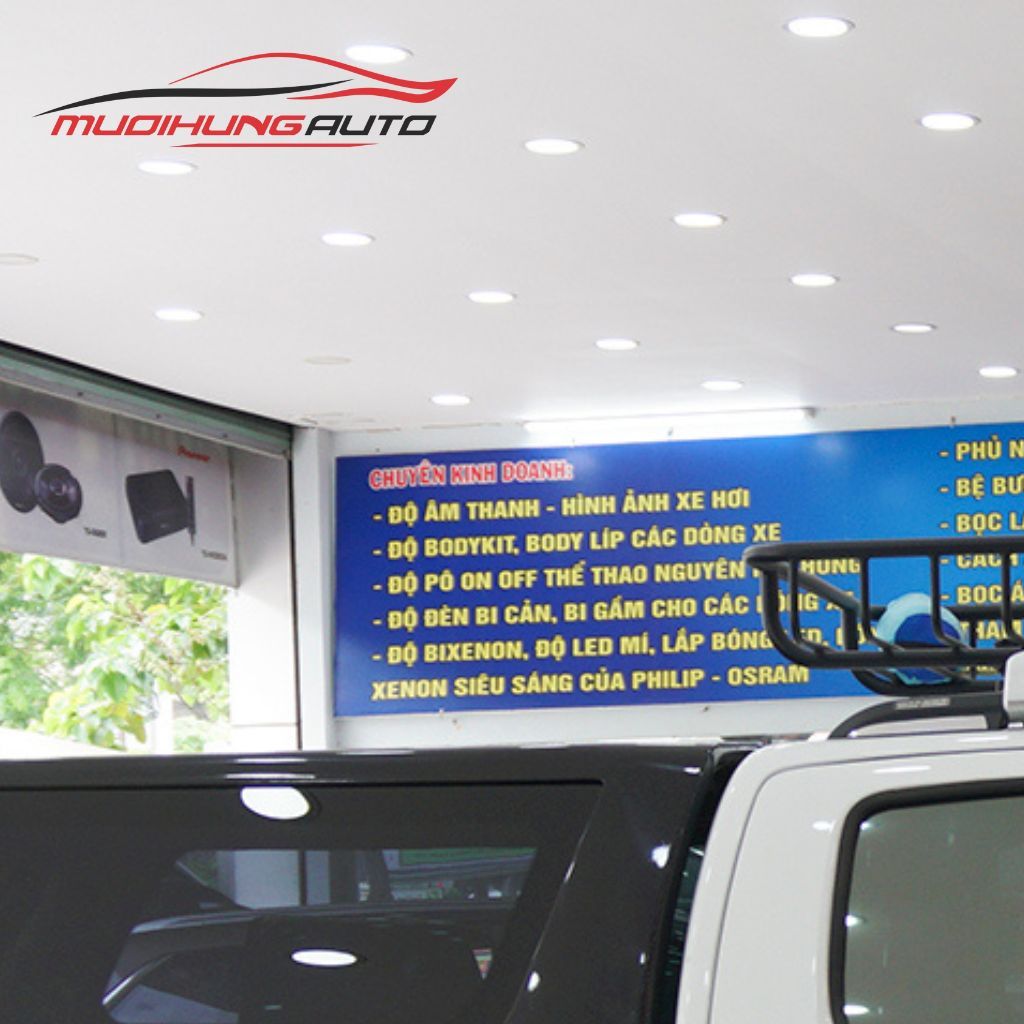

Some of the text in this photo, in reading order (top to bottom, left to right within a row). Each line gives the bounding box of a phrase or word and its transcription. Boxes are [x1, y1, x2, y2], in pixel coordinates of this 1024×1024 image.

[956, 436, 1001, 460] PHỦ
[369, 459, 574, 490] CHUYÊN KINH DOANH:
[956, 474, 984, 498] BỆ
[388, 501, 418, 526] ĐỘ
[424, 500, 460, 521] ÂM
[466, 499, 540, 520] THANH
[562, 494, 616, 516] HÌNH
[622, 489, 669, 512] ẢNH
[676, 491, 704, 510] XE
[712, 488, 749, 508] HƠI
[957, 513, 1001, 536] BỌC
[388, 536, 418, 561] ĐỘ
[424, 535, 519, 557] BODYKIT,
[526, 532, 583, 552] BODY
[631, 525, 676, 548] CÁC
[683, 523, 745, 546] DÒNG
[753, 523, 780, 542] XE
[388, 571, 418, 596] ĐỘ
[424, 570, 454, 592] PÔ
[461, 572, 492, 590] ON
[499, 569, 537, 589] OFF
[591, 564, 648, 584] THAO
[655, 557, 746, 583] NGUYÊN
[388, 606, 418, 632] ĐỘ
[424, 605, 469, 627] ĐÈN
[475, 606, 498, 625] BI
[564, 603, 587, 621] BI
[651, 598, 696, 618] CHO
[704, 593, 749, 616] CÁC
[387, 641, 417, 667] ĐỘ
[424, 641, 528, 662] BIXENON,
[535, 635, 566, 661] ĐỘ
[573, 637, 613, 656] LED
[372, 679, 448, 700] XENON
[454, 674, 505, 696] SIÊU
[511, 672, 573, 694] SÁNG
[632, 669, 704, 689] PHILIP
[728, 664, 809, 685] OSRAM
